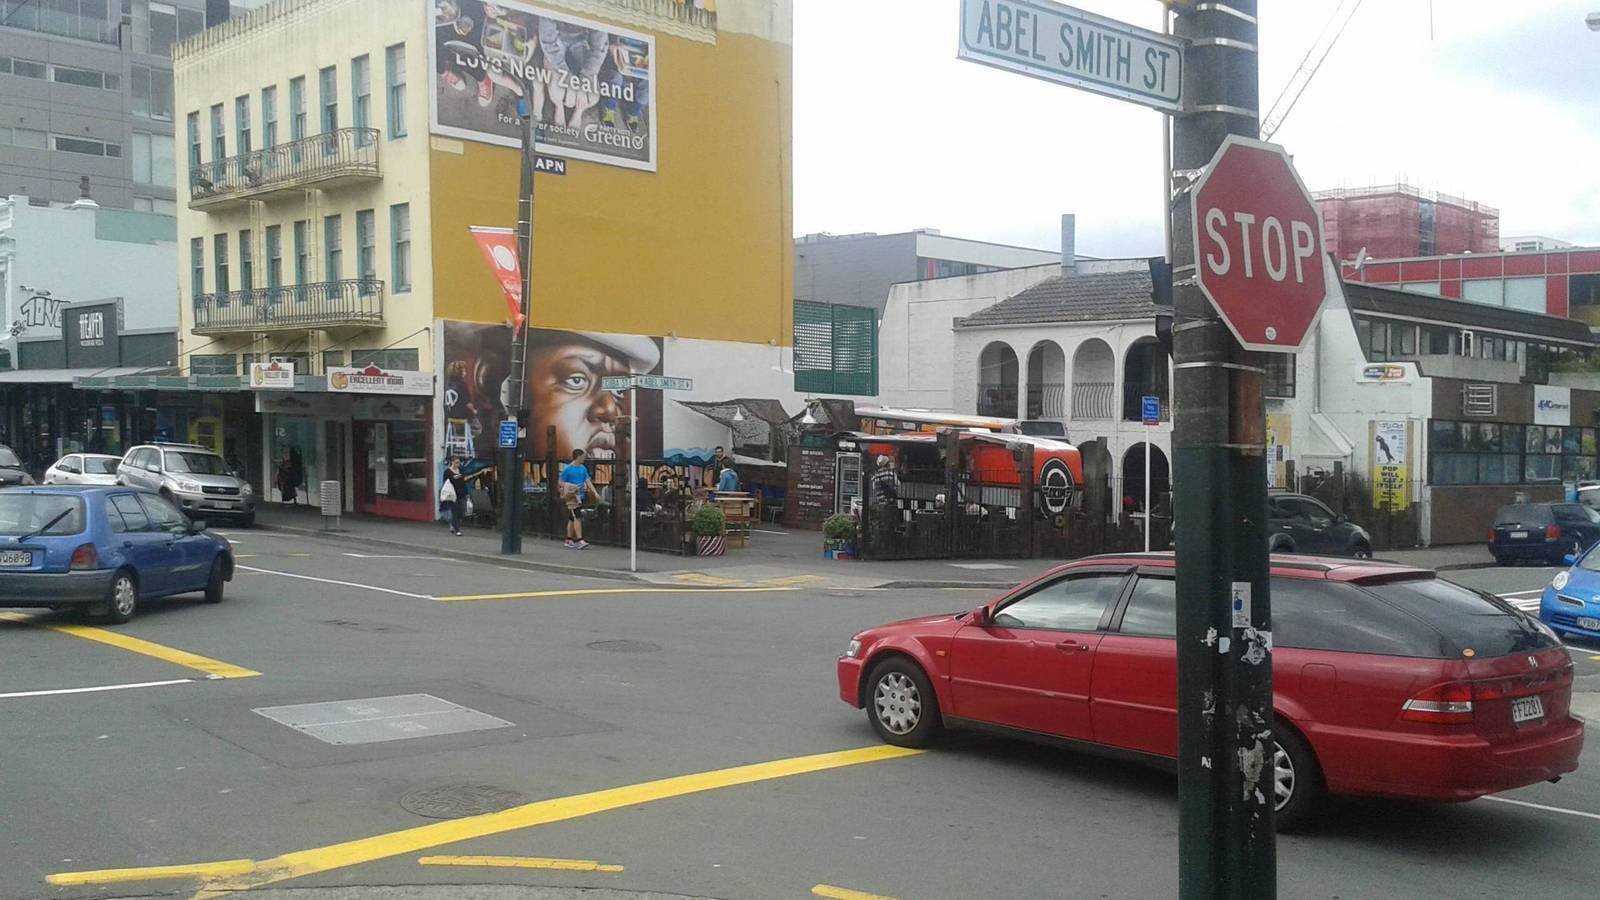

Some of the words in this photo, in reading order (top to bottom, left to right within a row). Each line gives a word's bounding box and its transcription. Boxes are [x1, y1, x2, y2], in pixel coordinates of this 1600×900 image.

[977, 0, 1046, 62] ABEL
[1059, 22, 1131, 83] SMITH
[1143, 47, 1170, 92] ST
[456, 53, 502, 74] Love
[510, 58, 551, 84] New
[558, 69, 634, 102] Zealand
[498, 113, 512, 124] For
[515, 118, 521, 126] a
[550, 123, 580, 138] society
[584, 124, 631, 149] Green
[535, 157, 565, 173] APN
[1205, 207, 1315, 284] STOP
[350, 375, 385, 386] EXCELLENT
[1512, 698, 1542, 720] FFZ281
